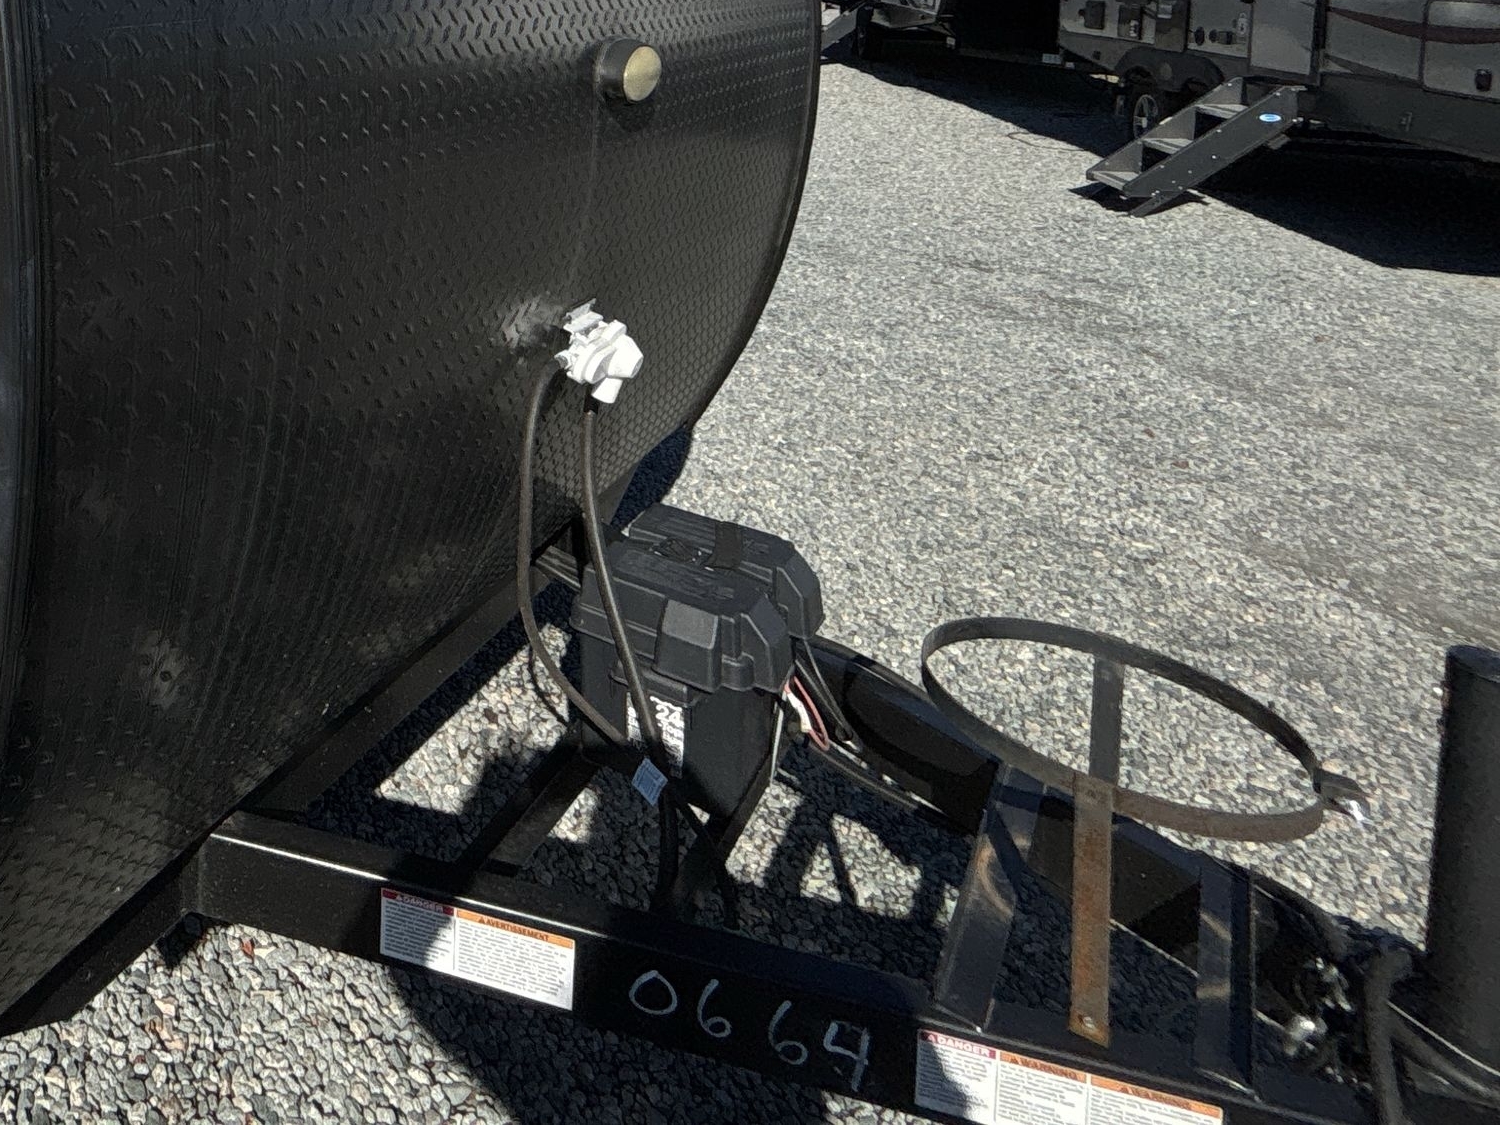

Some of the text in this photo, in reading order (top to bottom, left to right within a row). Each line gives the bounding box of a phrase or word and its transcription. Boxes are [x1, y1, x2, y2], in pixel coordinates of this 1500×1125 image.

[402, 895, 444, 913] DANGER
[486, 917, 550, 942] AVERTISSEMENT
[629, 970, 870, 1092] 0664
[937, 1035, 990, 1058] DANGER
